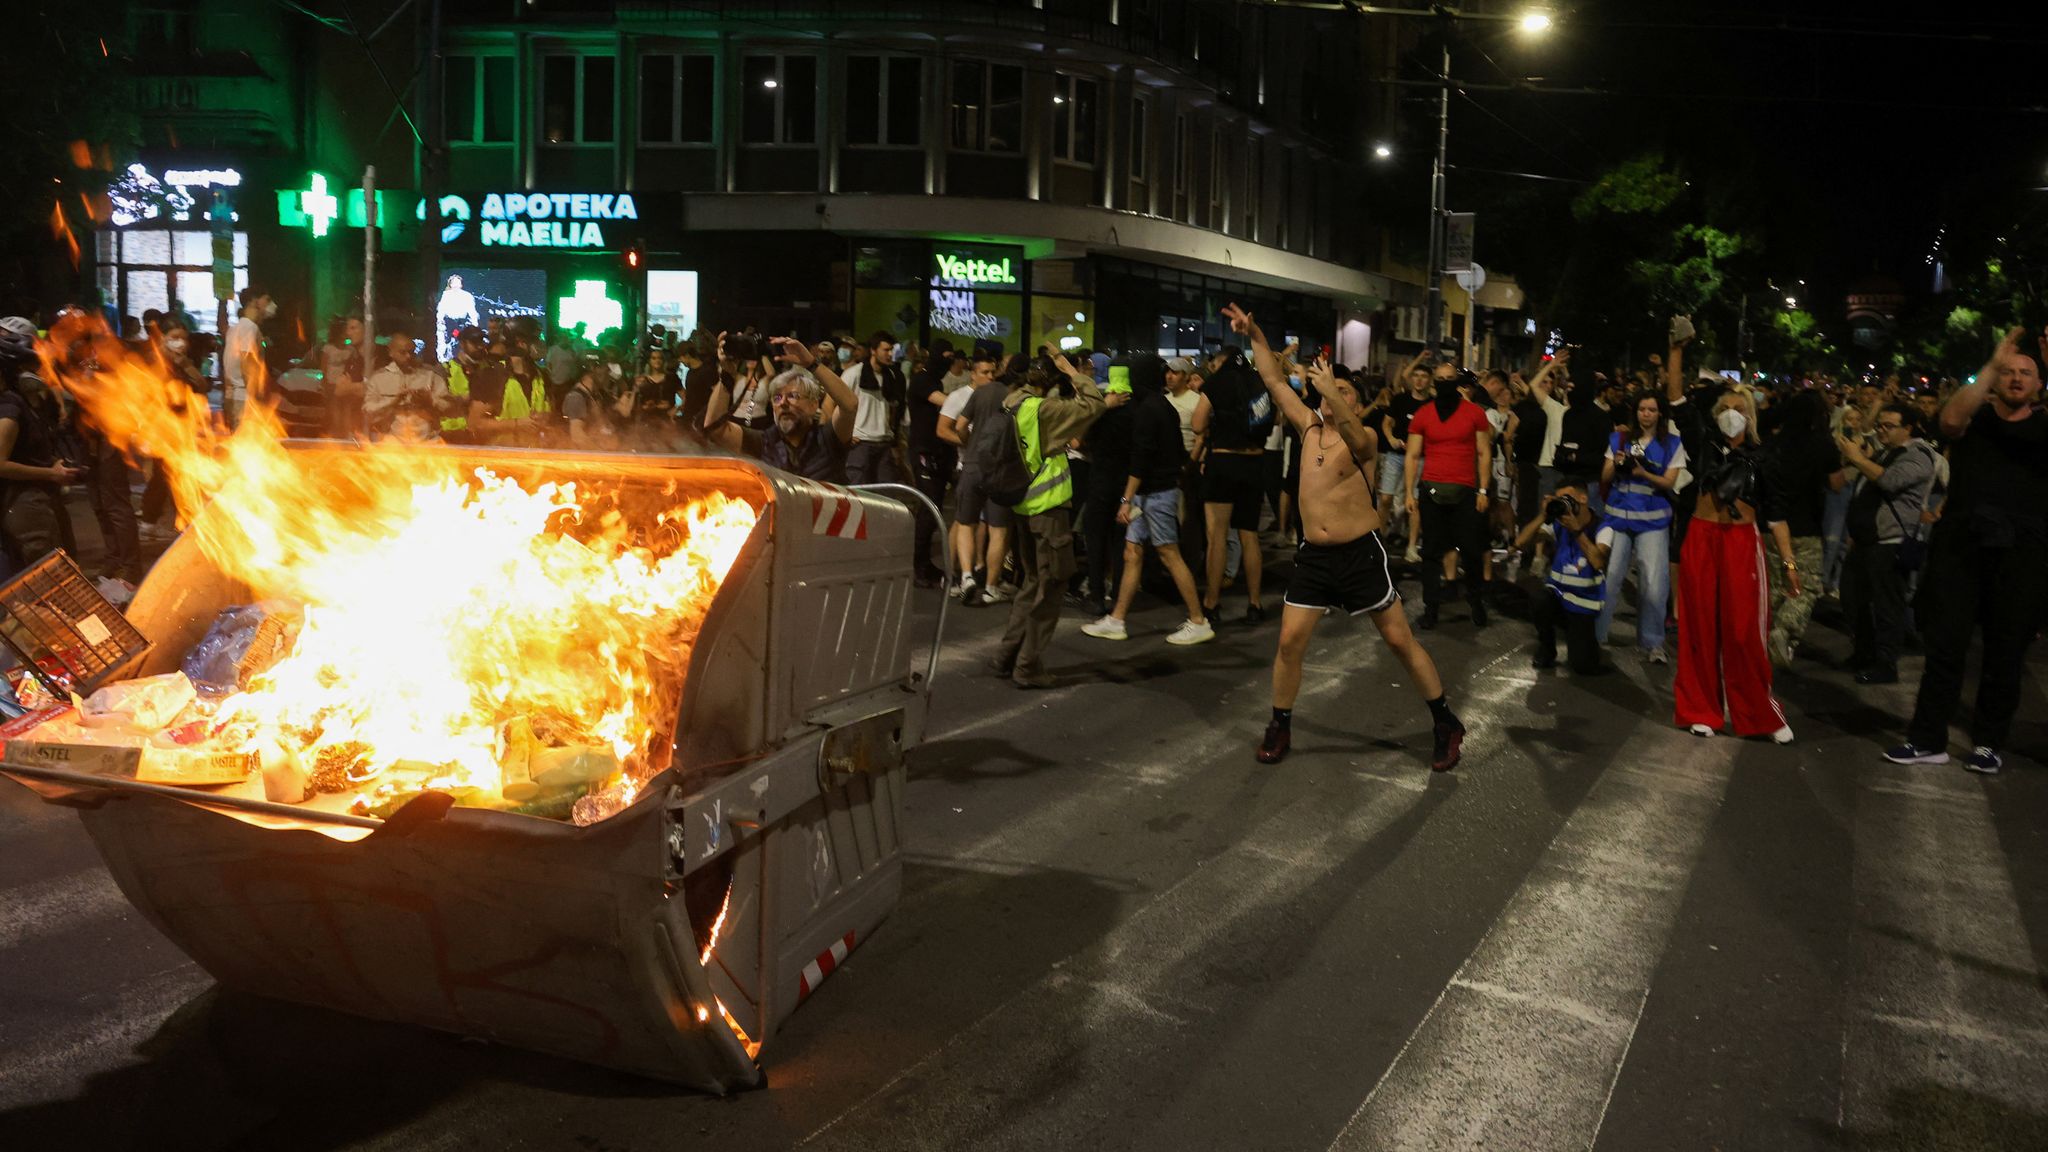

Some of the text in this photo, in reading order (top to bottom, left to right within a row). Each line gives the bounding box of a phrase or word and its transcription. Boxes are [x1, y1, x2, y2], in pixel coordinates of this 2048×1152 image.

[481, 193, 638, 220] APOTEKA
[481, 221, 605, 247] MAELIA
[210, 754, 238, 769] AMSTEL
